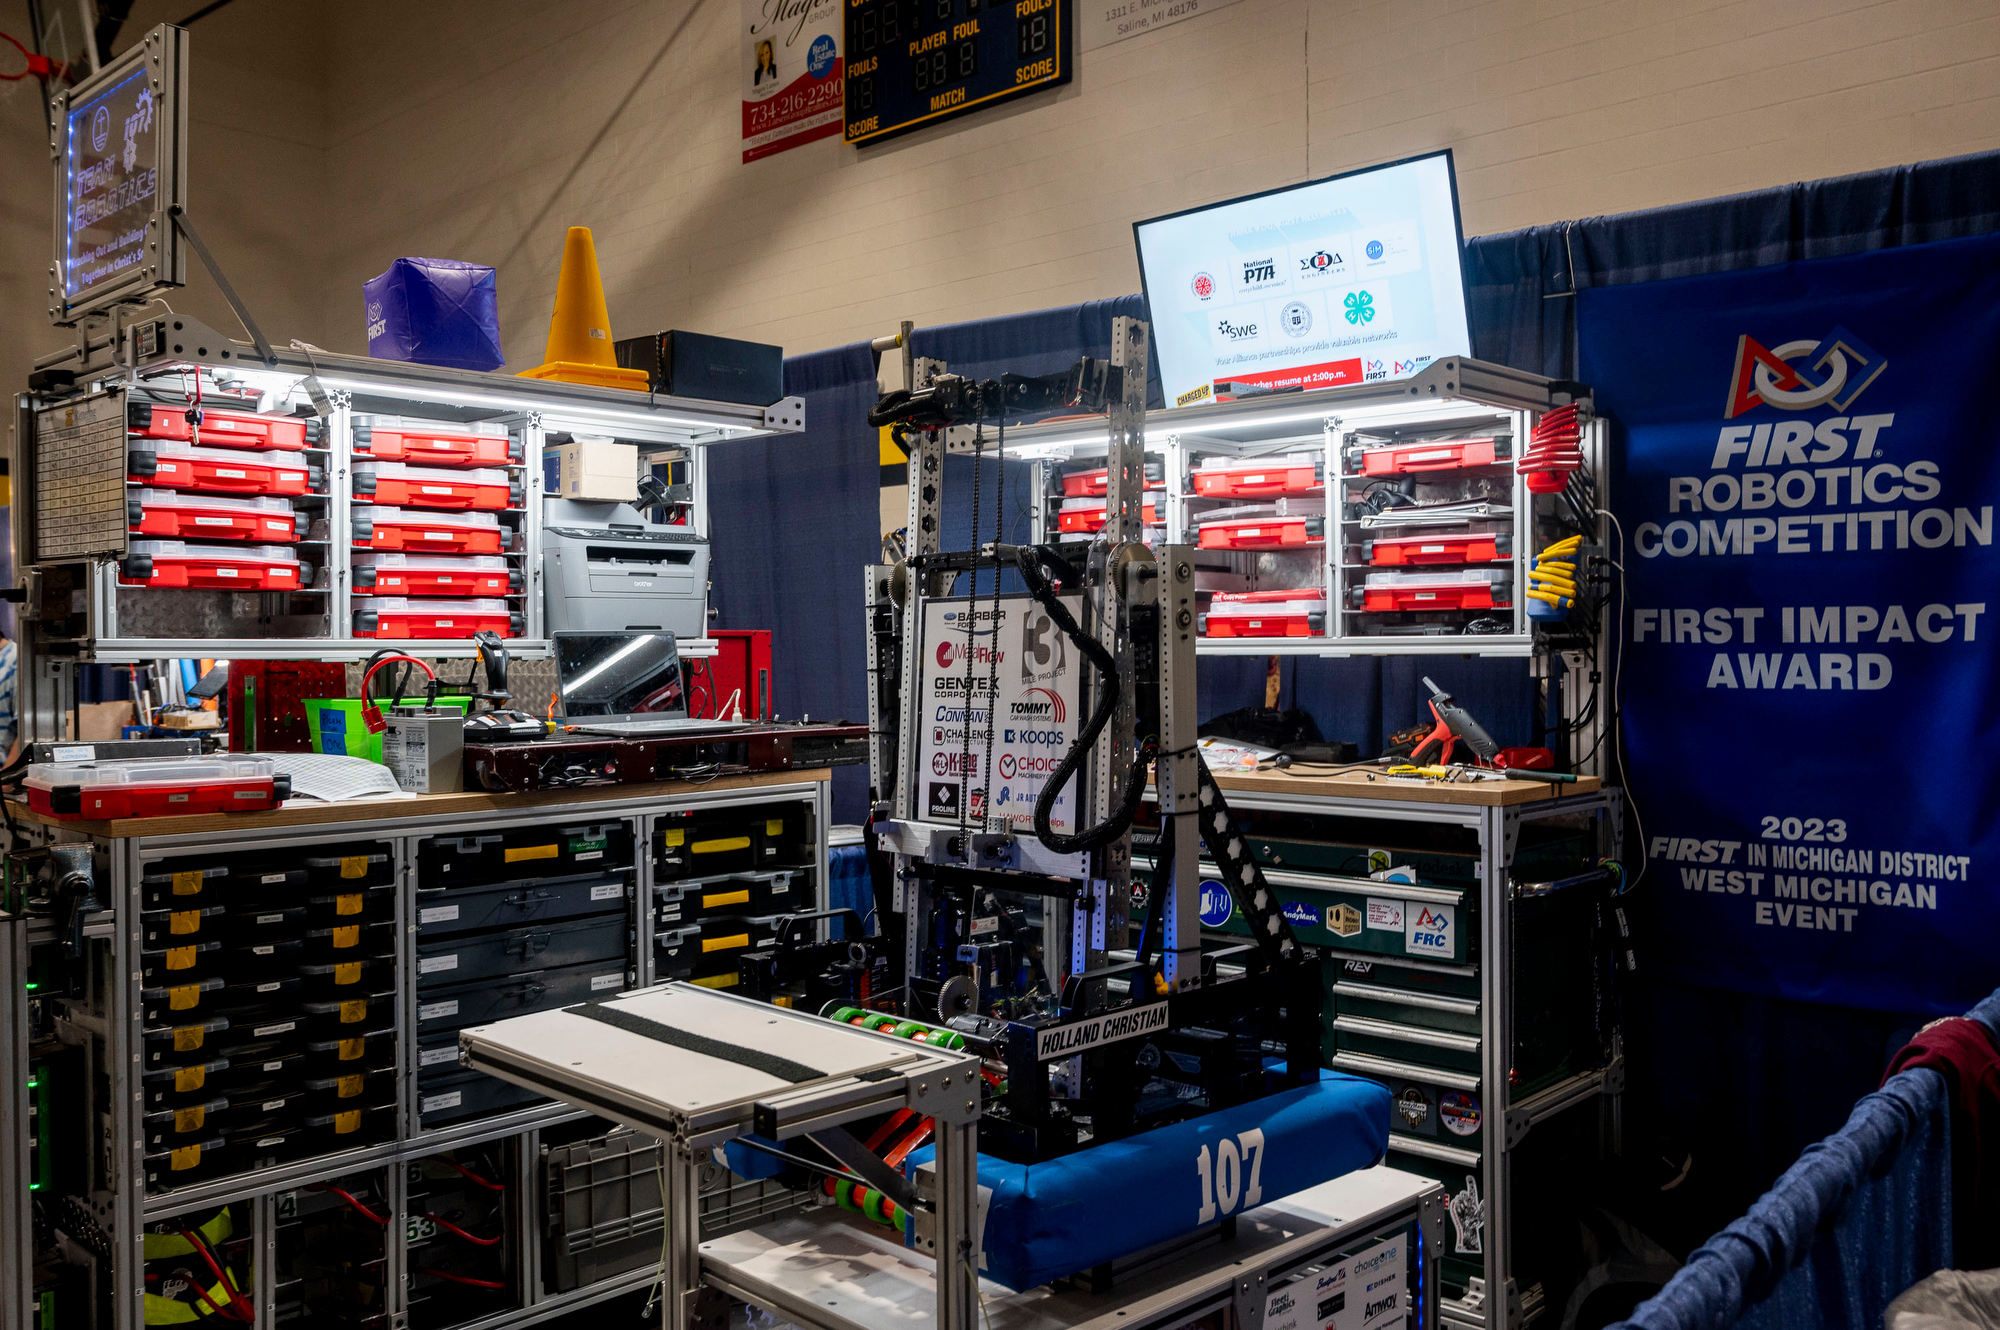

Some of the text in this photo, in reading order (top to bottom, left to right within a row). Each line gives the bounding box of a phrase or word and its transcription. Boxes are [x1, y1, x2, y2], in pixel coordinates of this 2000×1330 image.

[809, 6, 836, 24] GROUP
[1105, 4, 1139, 21] 1311 E.
[1117, 1, 1199, 35] Saline, MI 48176
[909, 19, 981, 56] PLAYER FOUL
[812, 40, 829, 55] Real
[814, 49, 836, 62] Estate
[809, 61, 825, 72] One
[848, 56, 878, 79] FOULS
[1016, 58, 1053, 83] SCORE
[930, 87, 966, 111] MATCH
[848, 116, 879, 138] SCORE
[76, 154, 116, 198] TEAM
[107, 236, 118, 253] and
[118, 228, 143, 249] Building
[1367, 245, 1382, 255] SIM
[114, 251, 137, 271] Christ's
[1244, 257, 1273, 270] National
[1243, 265, 1276, 284] PTA
[1302, 267, 1346, 280] ENGINEERS
[368, 318, 386, 341] FIRST
[1215, 330, 1398, 367] Your Alliance partnerships provide valuable networks
[1415, 355, 1431, 363] FIRST
[1274, 377, 1302, 388] resume
[1303, 374, 1312, 383] at
[1365, 370, 1388, 381] FIRST
[1177, 388, 1200, 406] CHARGED
[1710, 413, 1895, 470] FIRST
[1669, 460, 1941, 514] ROBOTICS
[1634, 505, 1993, 558] COMPETITION
[634, 580, 653, 588] brother
[1633, 603, 1986, 644] FIRST IMPACT
[1022, 668, 1067, 686] MILE PROJECT
[1706, 653, 1893, 690] AWARD
[934, 691, 1000, 699] CORPOATION
[1010, 702, 1053, 715] TOMMY
[1018, 772, 1044, 780] MACHINERY
[931, 805, 956, 813] PROLINE
[1760, 815, 1848, 843] 2023
[1649, 836, 1970, 881] FIRST IN MICHIGAN DISTRICT
[1680, 868, 1937, 910] WEST MICHIGAN
[1345, 906, 1356, 915] THE
[1755, 901, 1858, 932] EVENT
[1414, 932, 1446, 947] FRC
[1344, 961, 1372, 973] REV
[1040, 1005, 1168, 1056] HOLLAND CHRISTIAN
[407, 1163, 421, 1182] 6
[1196, 1127, 1265, 1226] 107
[279, 1196, 296, 1217] 4
[1373, 1274, 1396, 1289] DISHER
[1268, 1300, 1295, 1318] Graphics
[1364, 1293, 1398, 1320] Amway
